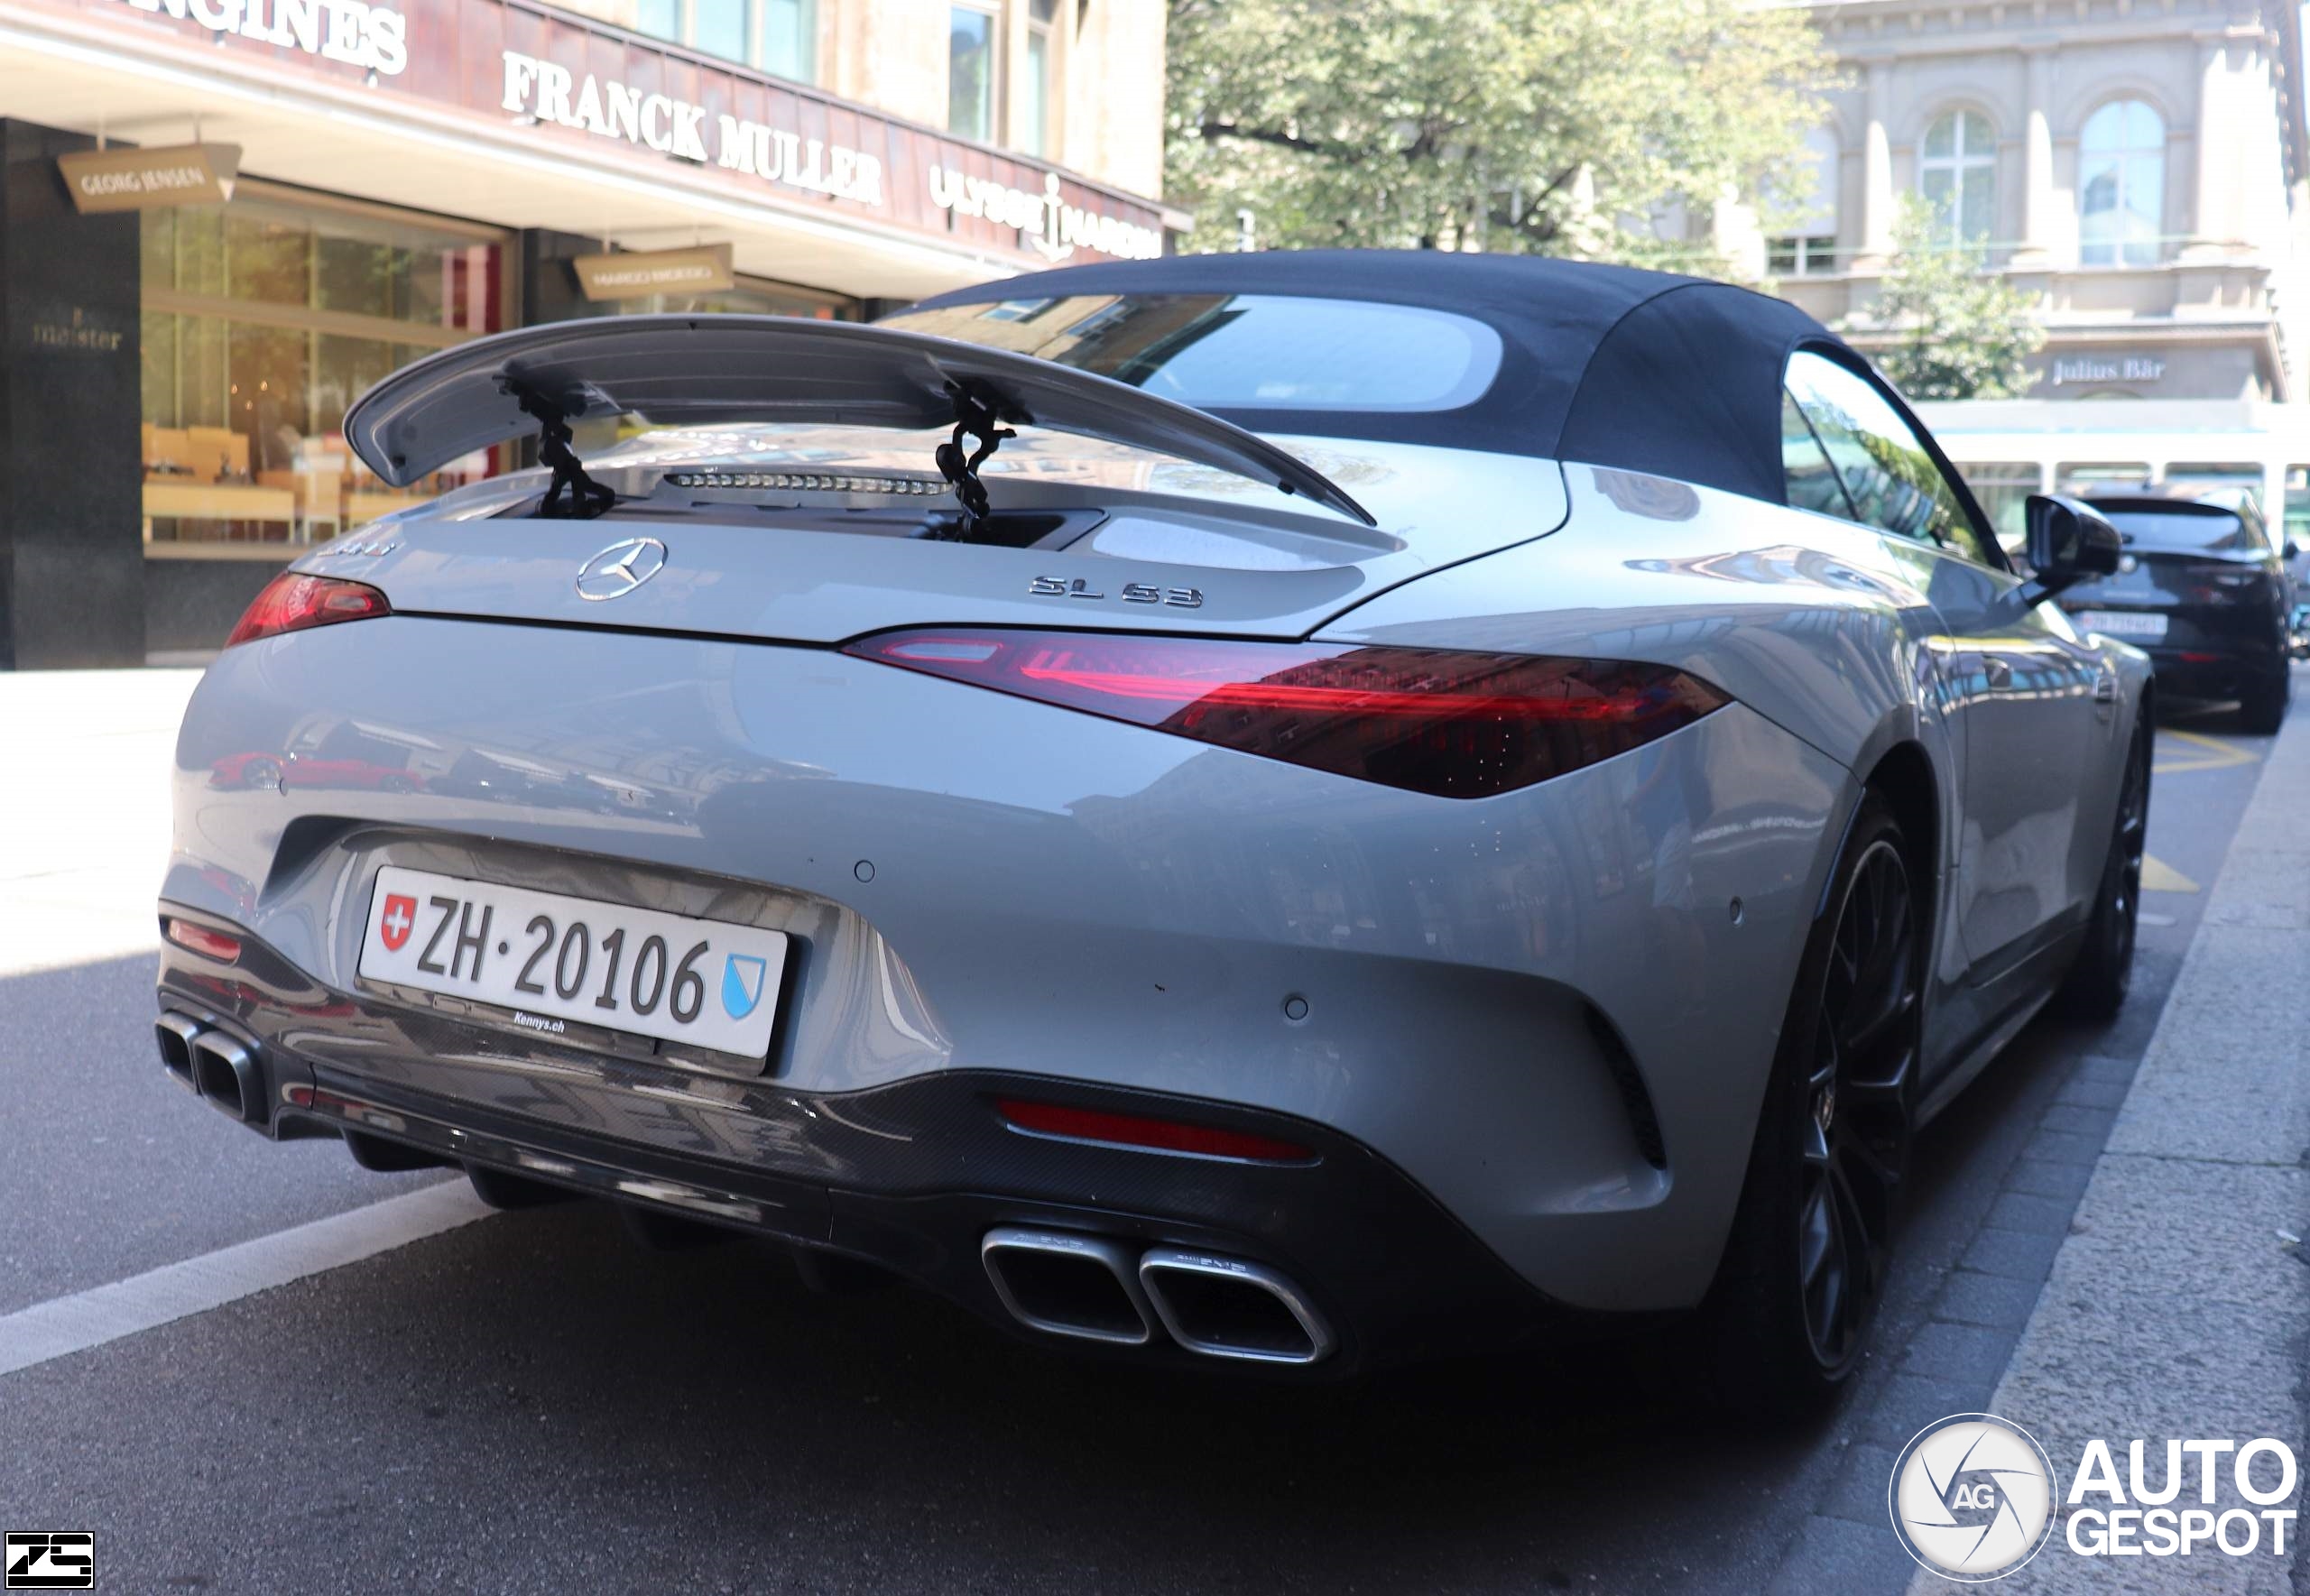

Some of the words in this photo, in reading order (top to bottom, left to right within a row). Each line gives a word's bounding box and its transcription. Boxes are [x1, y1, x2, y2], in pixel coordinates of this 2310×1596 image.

[502, 51, 707, 162] FRANCK
[718, 114, 882, 207] MULLER
[81, 171, 142, 197] GEORG
[141, 166, 206, 193] JENSEN
[2053, 359, 2118, 385] Julius
[2122, 359, 2165, 381] Bär
[1029, 576, 1104, 599] SL
[1122, 583, 1203, 609] 63
[513, 1010, 565, 1033] Kennys.ch
